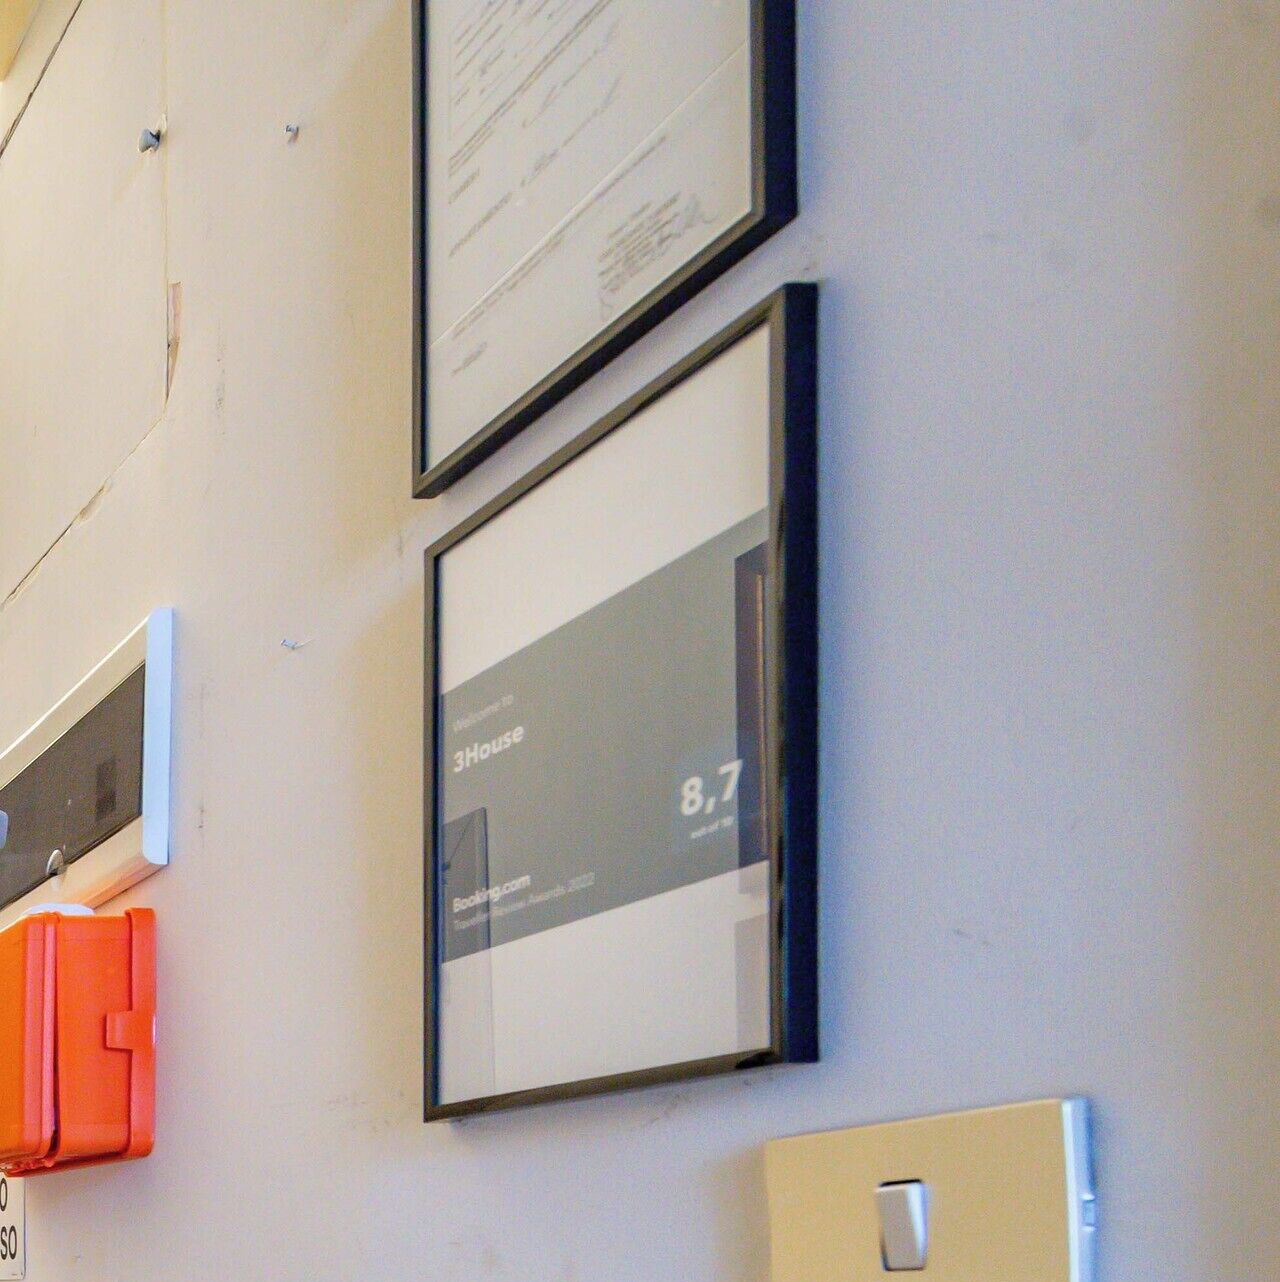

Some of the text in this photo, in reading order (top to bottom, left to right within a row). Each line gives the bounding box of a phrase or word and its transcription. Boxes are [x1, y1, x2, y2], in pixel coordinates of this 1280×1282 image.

[453, 726, 525, 773] 3House
[680, 760, 743, 816] 8,7
[452, 874, 533, 914] Booking.com
